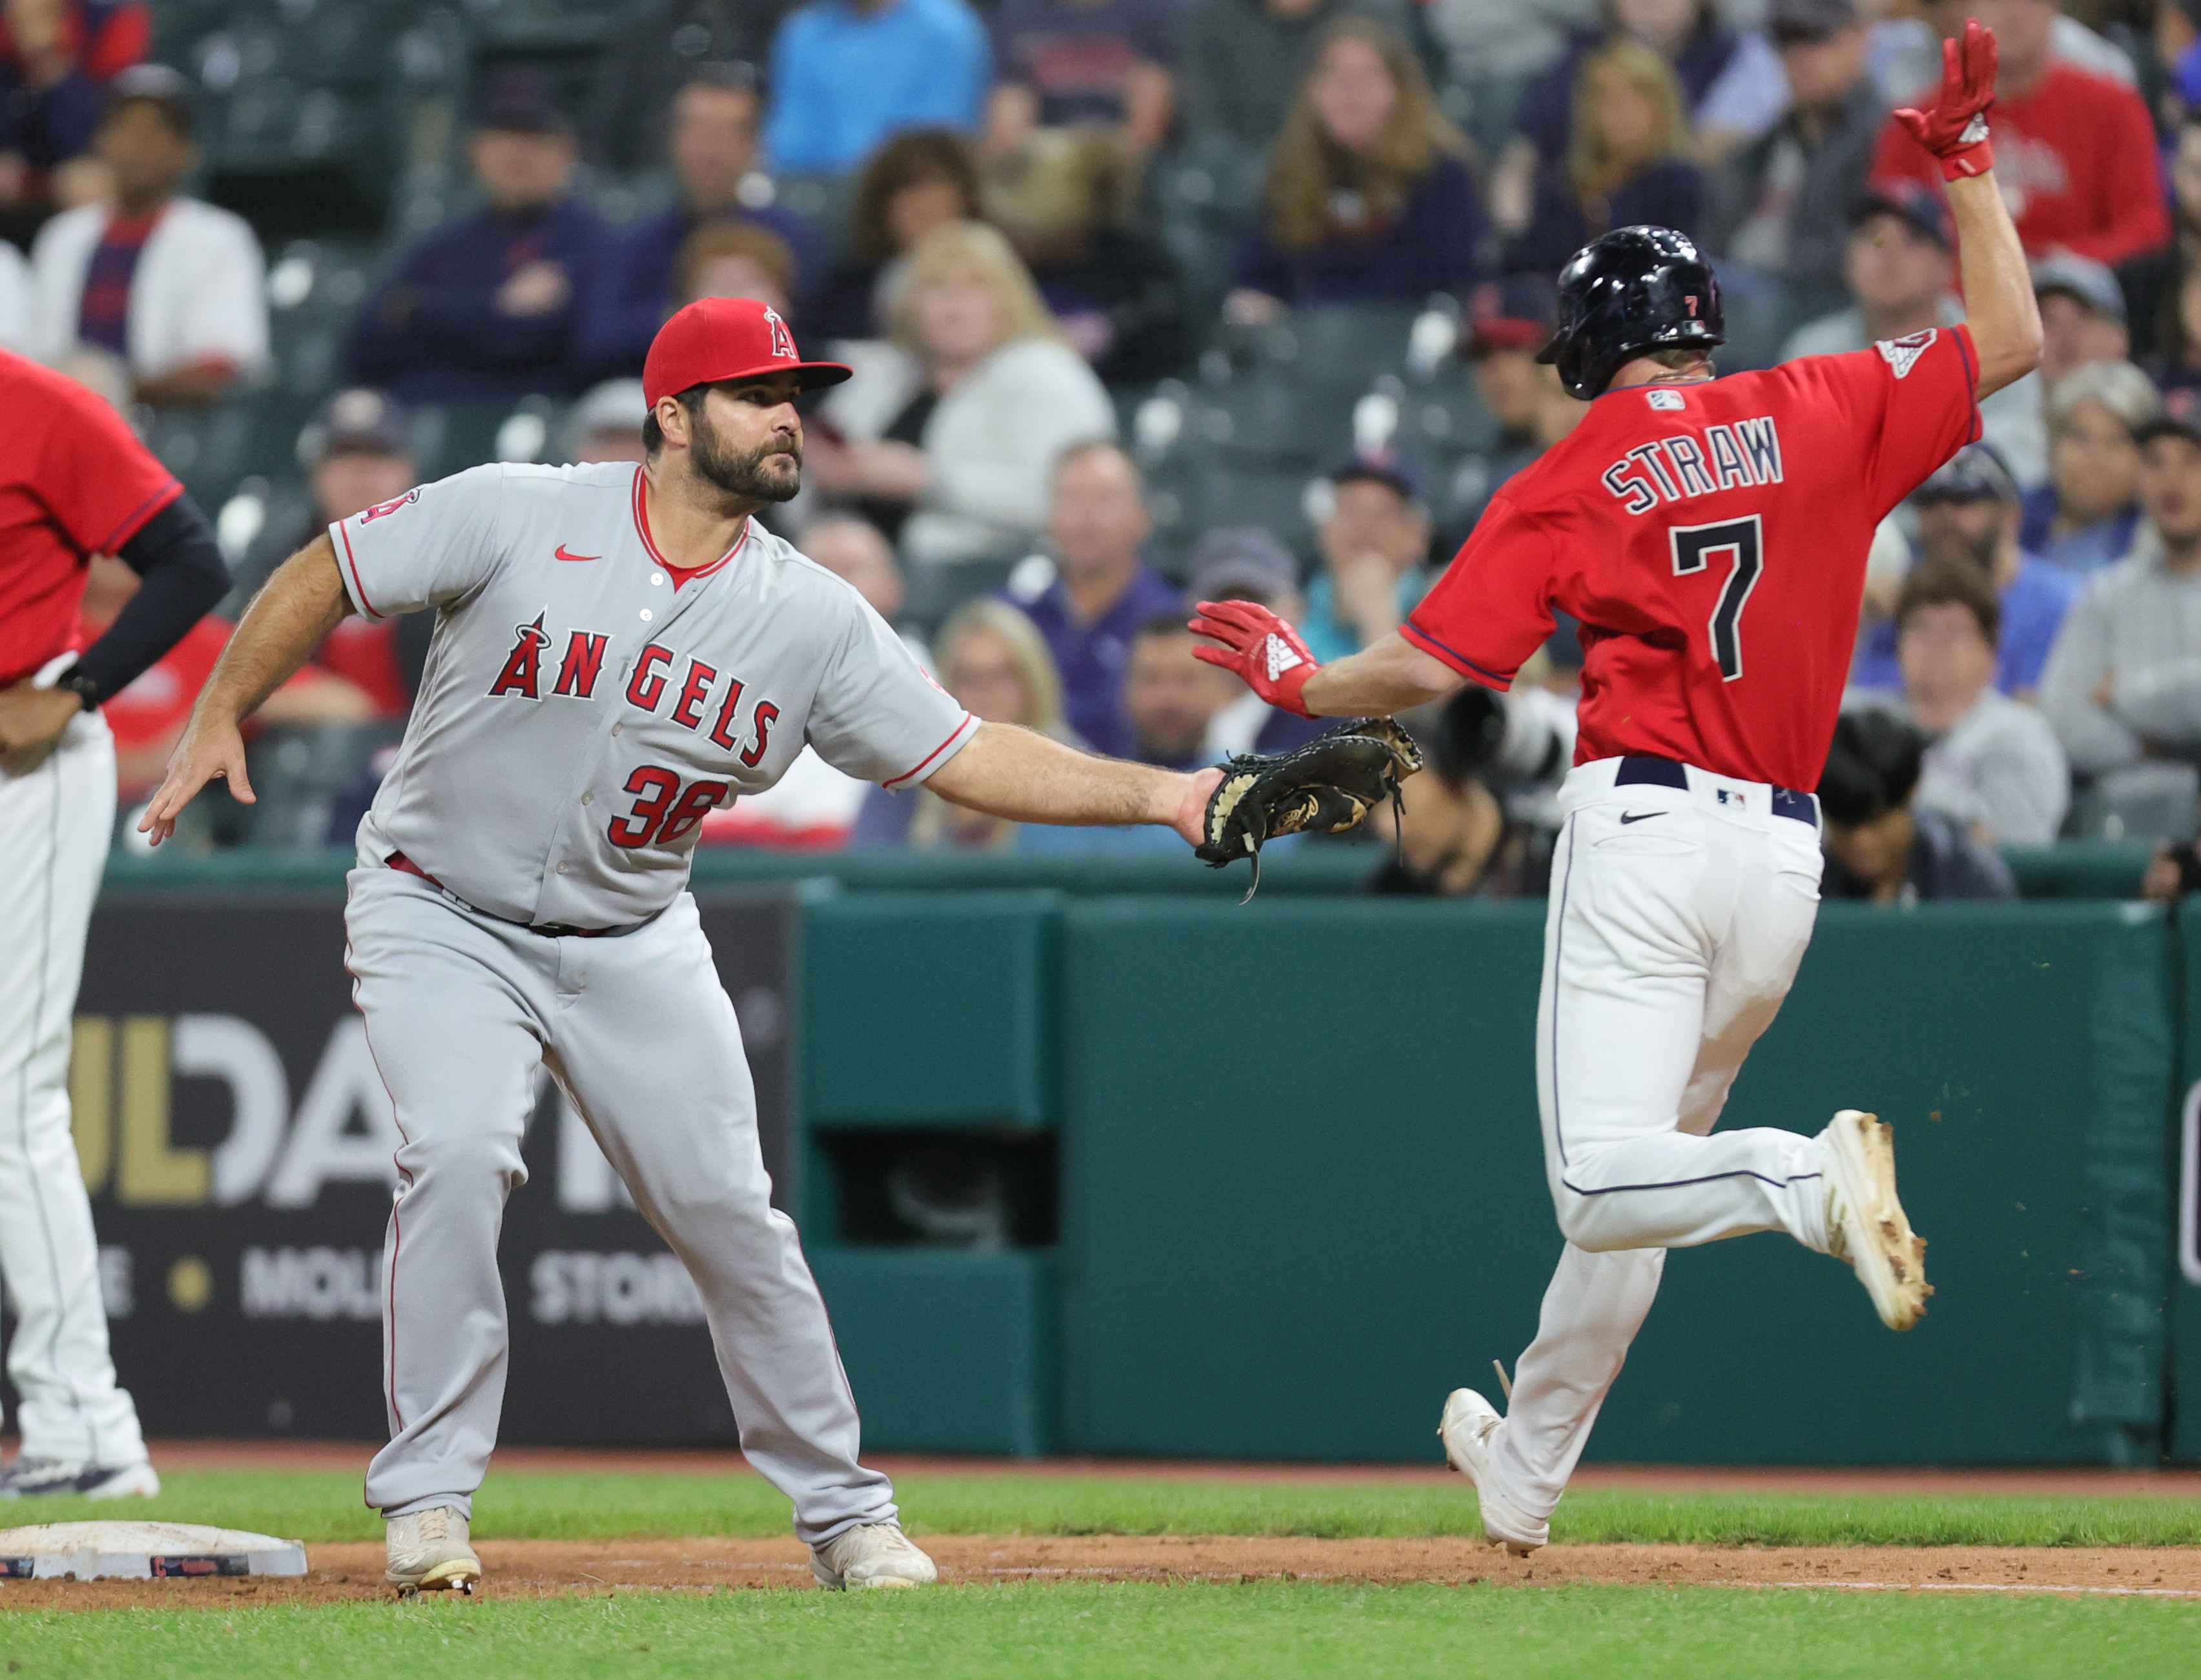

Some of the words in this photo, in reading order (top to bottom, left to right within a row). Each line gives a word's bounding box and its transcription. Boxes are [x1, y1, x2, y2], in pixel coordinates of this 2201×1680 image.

[763, 305, 798, 360] A
[1684, 295, 1698, 317] 7
[1601, 415, 1784, 516] STRAW
[1668, 513, 1764, 683] 7
[483, 602, 783, 770] ANGELS
